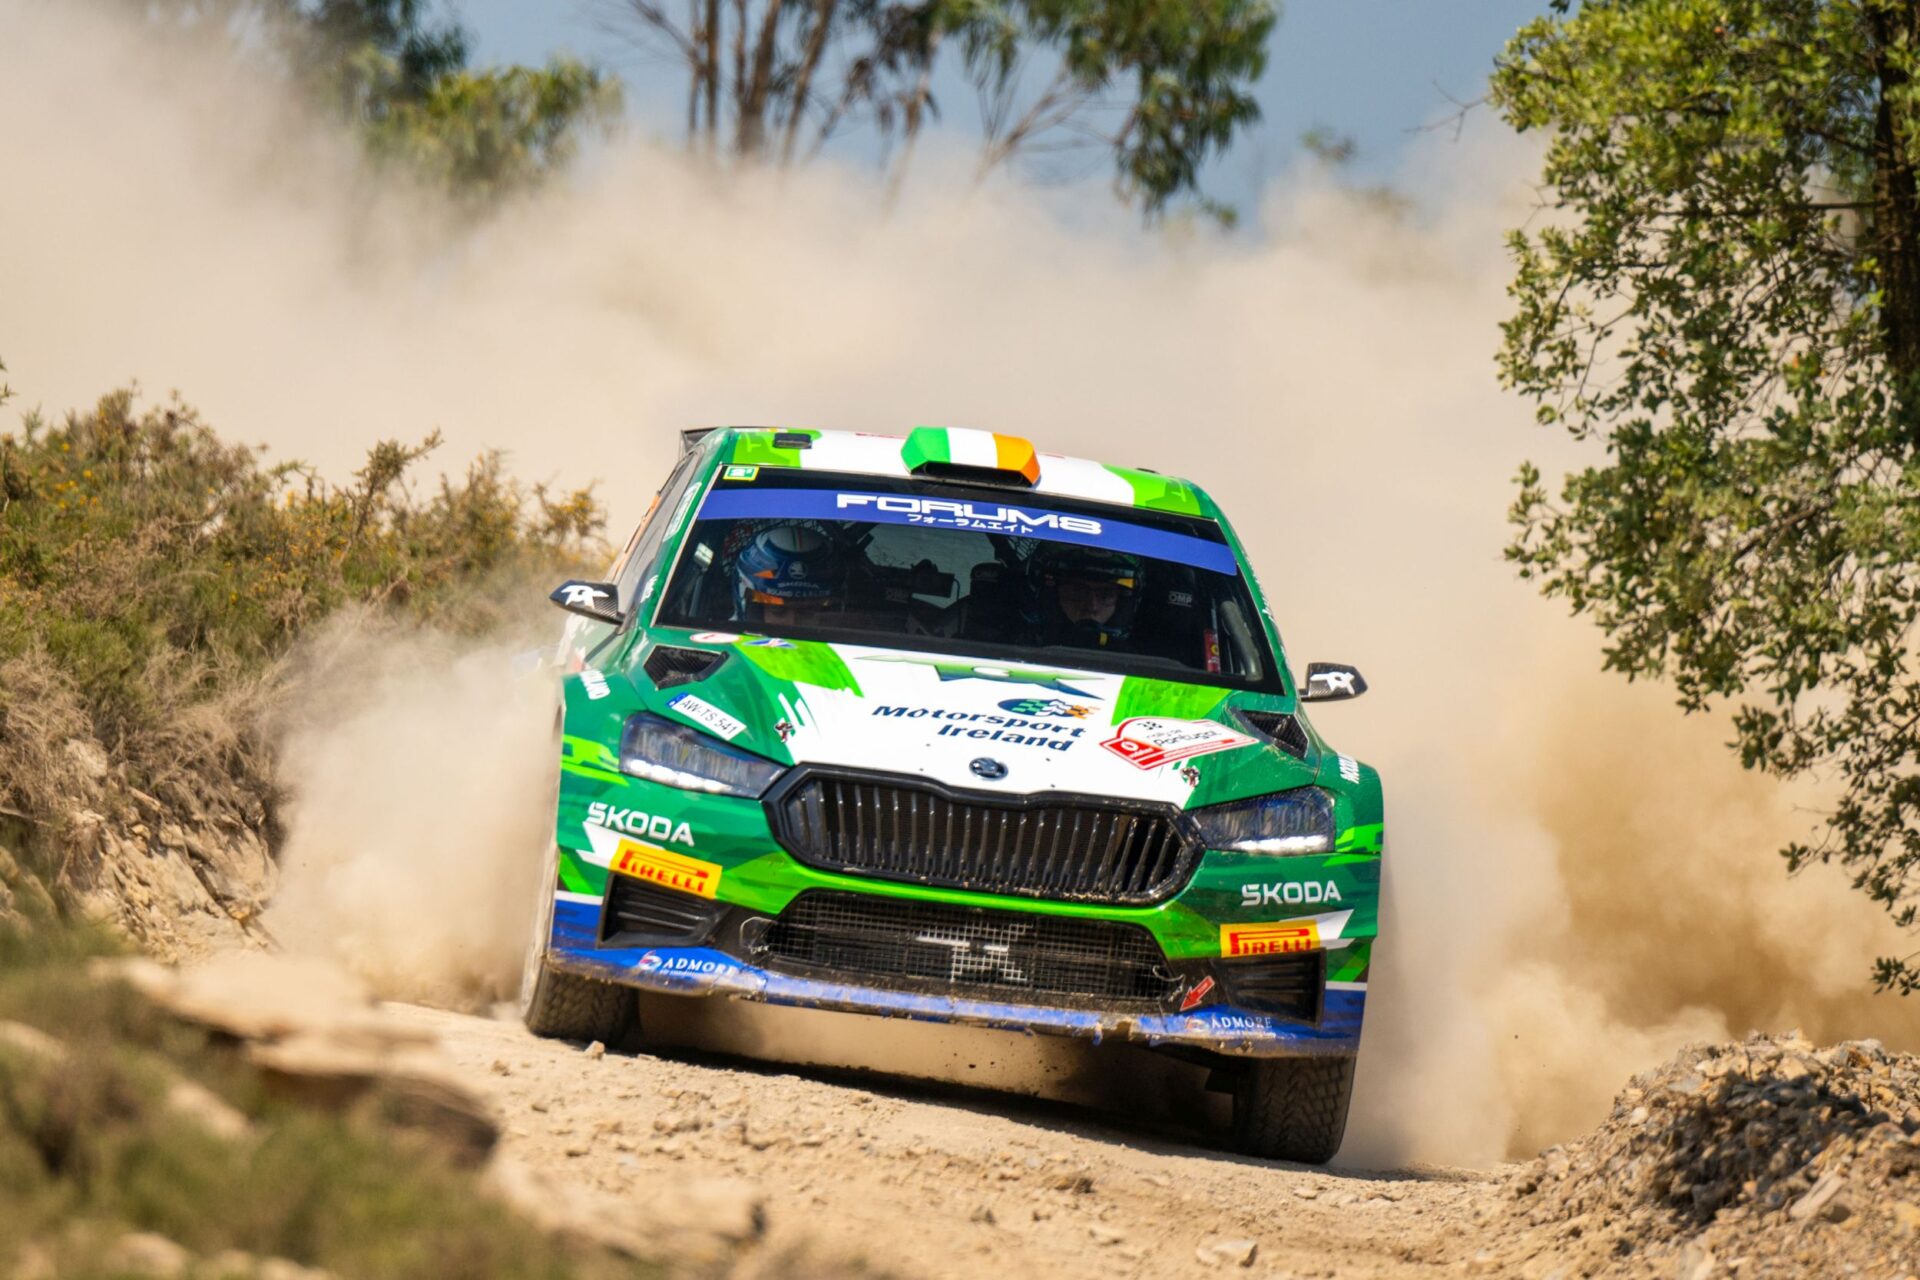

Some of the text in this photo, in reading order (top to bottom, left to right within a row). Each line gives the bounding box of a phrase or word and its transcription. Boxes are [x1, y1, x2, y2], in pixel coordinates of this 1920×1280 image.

[837, 493, 1102, 535] FORUM8
[907, 513, 1033, 534] フォーラムエイト
[714, 718, 738, 735] 541
[871, 705, 1087, 738] Motorsport
[937, 724, 1074, 751] Ireland
[618, 849, 710, 893] PIRELLI
[1229, 928, 1312, 956] PIRELLI
[1211, 1015, 1273, 1030] ADMORE
